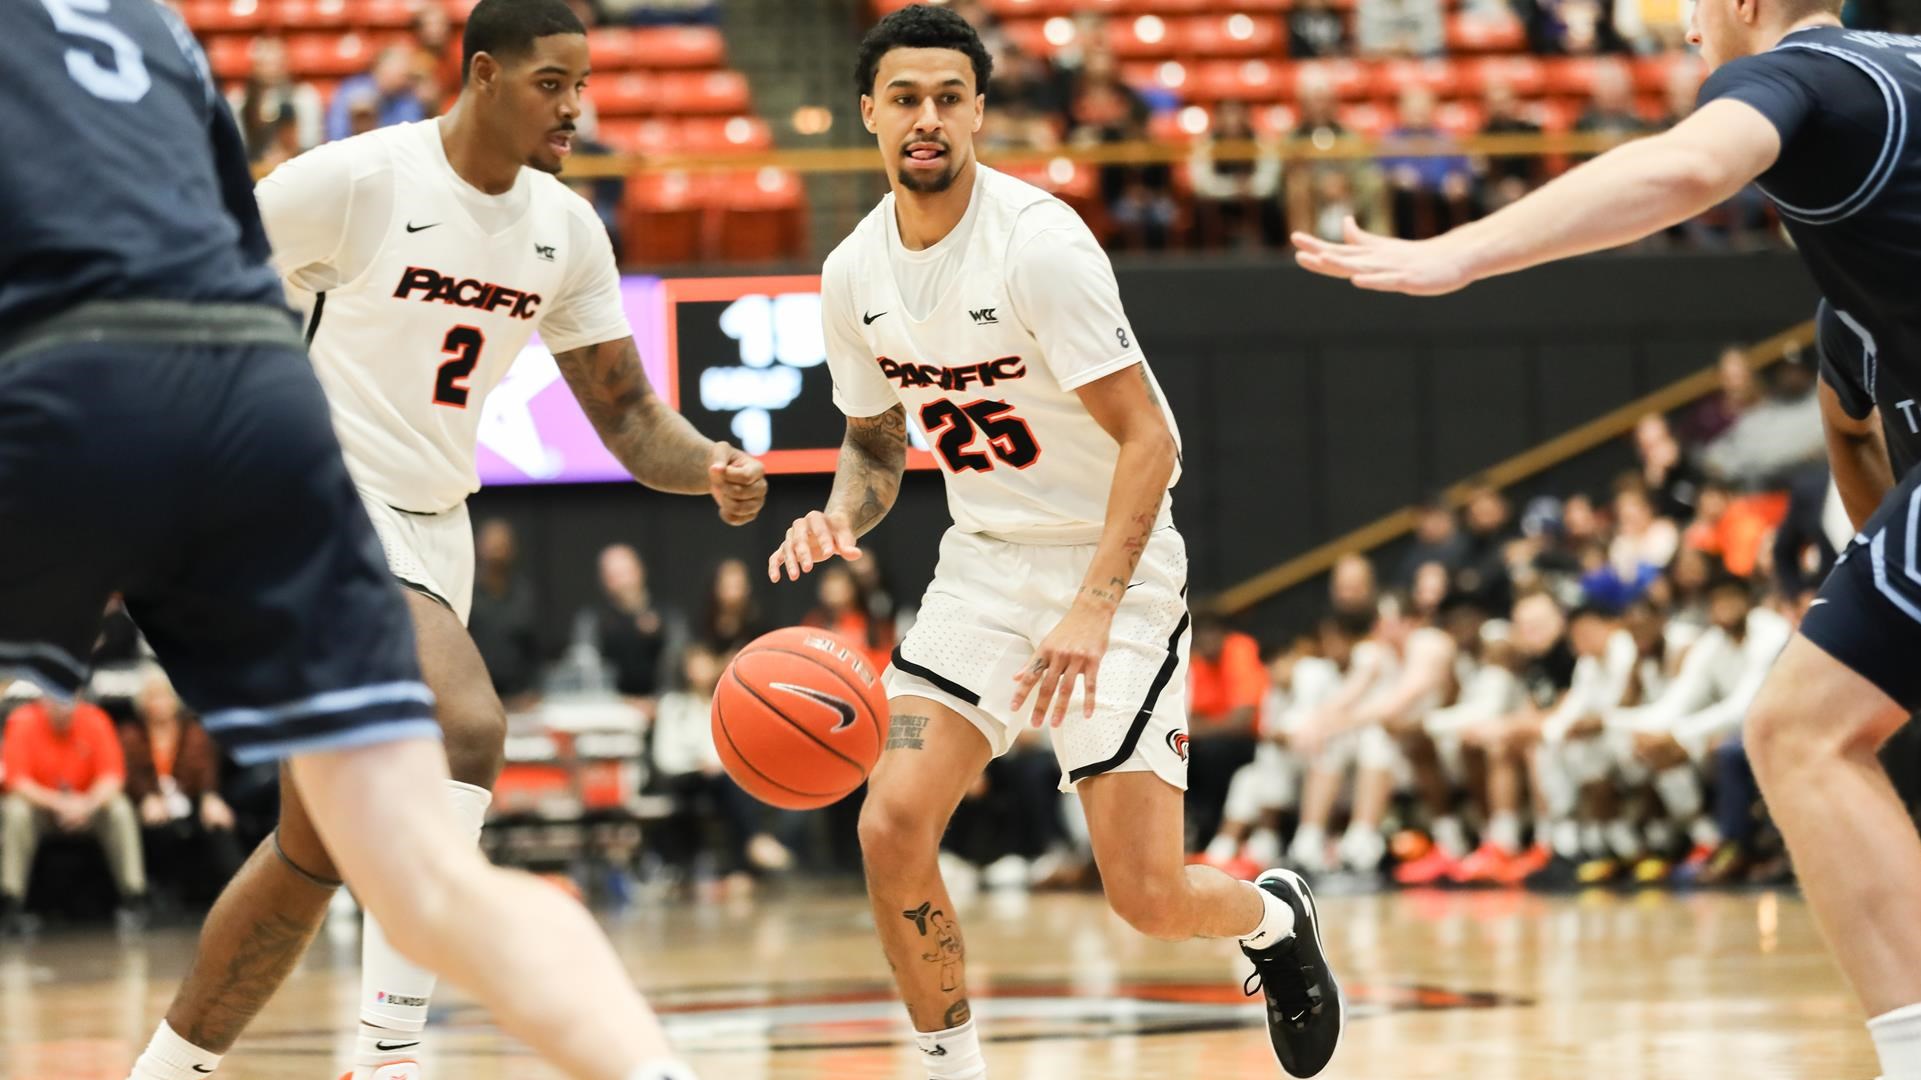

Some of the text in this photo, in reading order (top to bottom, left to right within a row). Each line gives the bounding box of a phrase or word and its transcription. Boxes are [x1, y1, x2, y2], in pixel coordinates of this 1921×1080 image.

[392, 265, 542, 320] PACIFIC
[968, 308, 999, 324] WCC
[431, 323, 486, 409] 2
[876, 355, 1026, 392] PACIFIC
[918, 397, 1042, 475] 25
